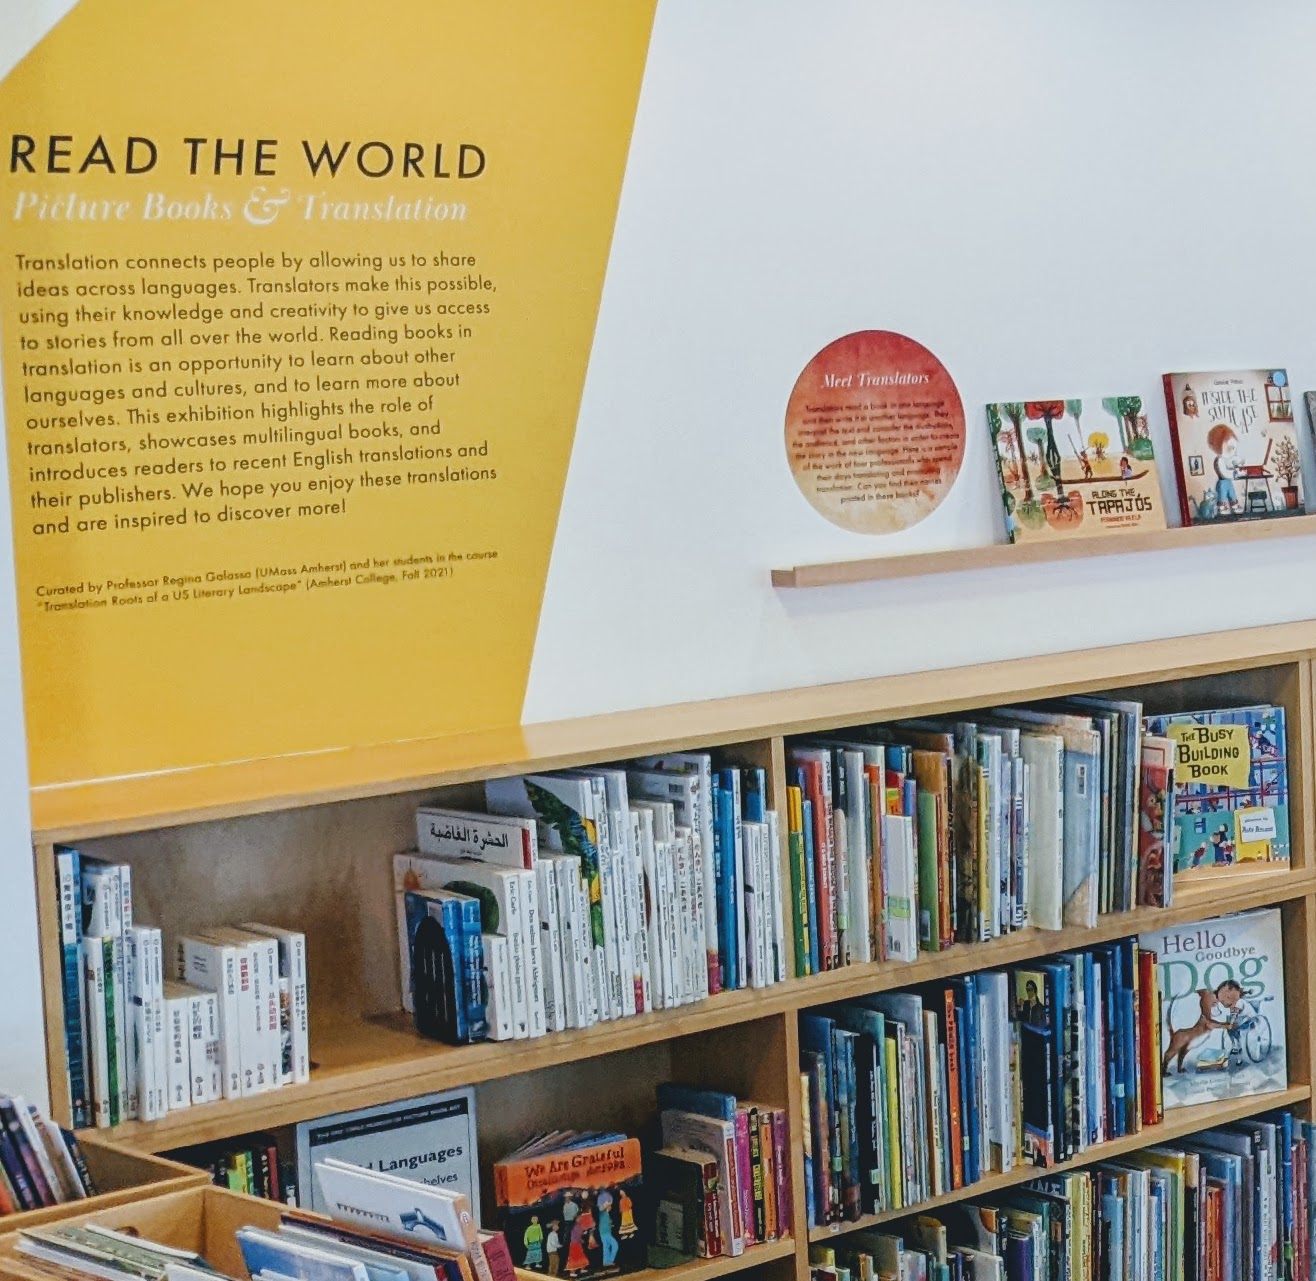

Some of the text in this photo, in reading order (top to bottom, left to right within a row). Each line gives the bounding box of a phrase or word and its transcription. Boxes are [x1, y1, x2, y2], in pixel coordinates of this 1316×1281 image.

[9, 133, 486, 180] READ THE WORLD
[12, 186, 468, 226] Picture Books & Translation
[14, 250, 476, 273] Translation connects people by allowing us to share
[17, 273, 497, 300] ideas across languages. Translators make this possible,
[19, 301, 490, 328] using their knowledge and creativity to give us access
[20, 322, 472, 351] to stories from all over the world. Reading books in
[22, 346, 456, 377] translation is an opportunity to learn about other
[24, 370, 460, 407] languages and cultures, and to learn more about
[821, 371, 930, 388] Meet Translators
[1236, 388, 1258, 403] THE
[26, 394, 434, 430] ourselves. This exhibition highlights the role of
[1207, 404, 1260, 434] SUITCASE
[27, 418, 441, 456] translators, showcases multilingual books, and
[29, 439, 488, 483] introduces readers to recent English translations and
[30, 465, 497, 511] their publishers. We hope you enjoy these translations
[1091, 488, 1135, 499] ALONG THE
[32, 497, 346, 536] and are inspired to discover more!
[1086, 493, 1153, 515] TAPAJÓS
[35, 581, 85, 597] Curated
[87, 581, 103, 595] by
[106, 577, 160, 591] Professor
[349, 557, 371, 571] and
[372, 557, 390, 568] her
[436, 553, 446, 563] in
[447, 551, 463, 562] the
[465, 550, 499, 561] course
[1181, 727, 1234, 744] THE BUSY
[1177, 744, 1240, 764] BUILDING
[1187, 764, 1229, 779] BOOK
[473, 829, 509, 851] الحشرة
[1161, 930, 1227, 956] Hello
[1195, 946, 1256, 962] Goodbye
[1158, 955, 1269, 1002] Dog
[379, 1145, 463, 1173] Languages
[525, 1164, 546, 1178] We
[549, 1160, 570, 1174] Are
[571, 1146, 625, 1168] Grateful
